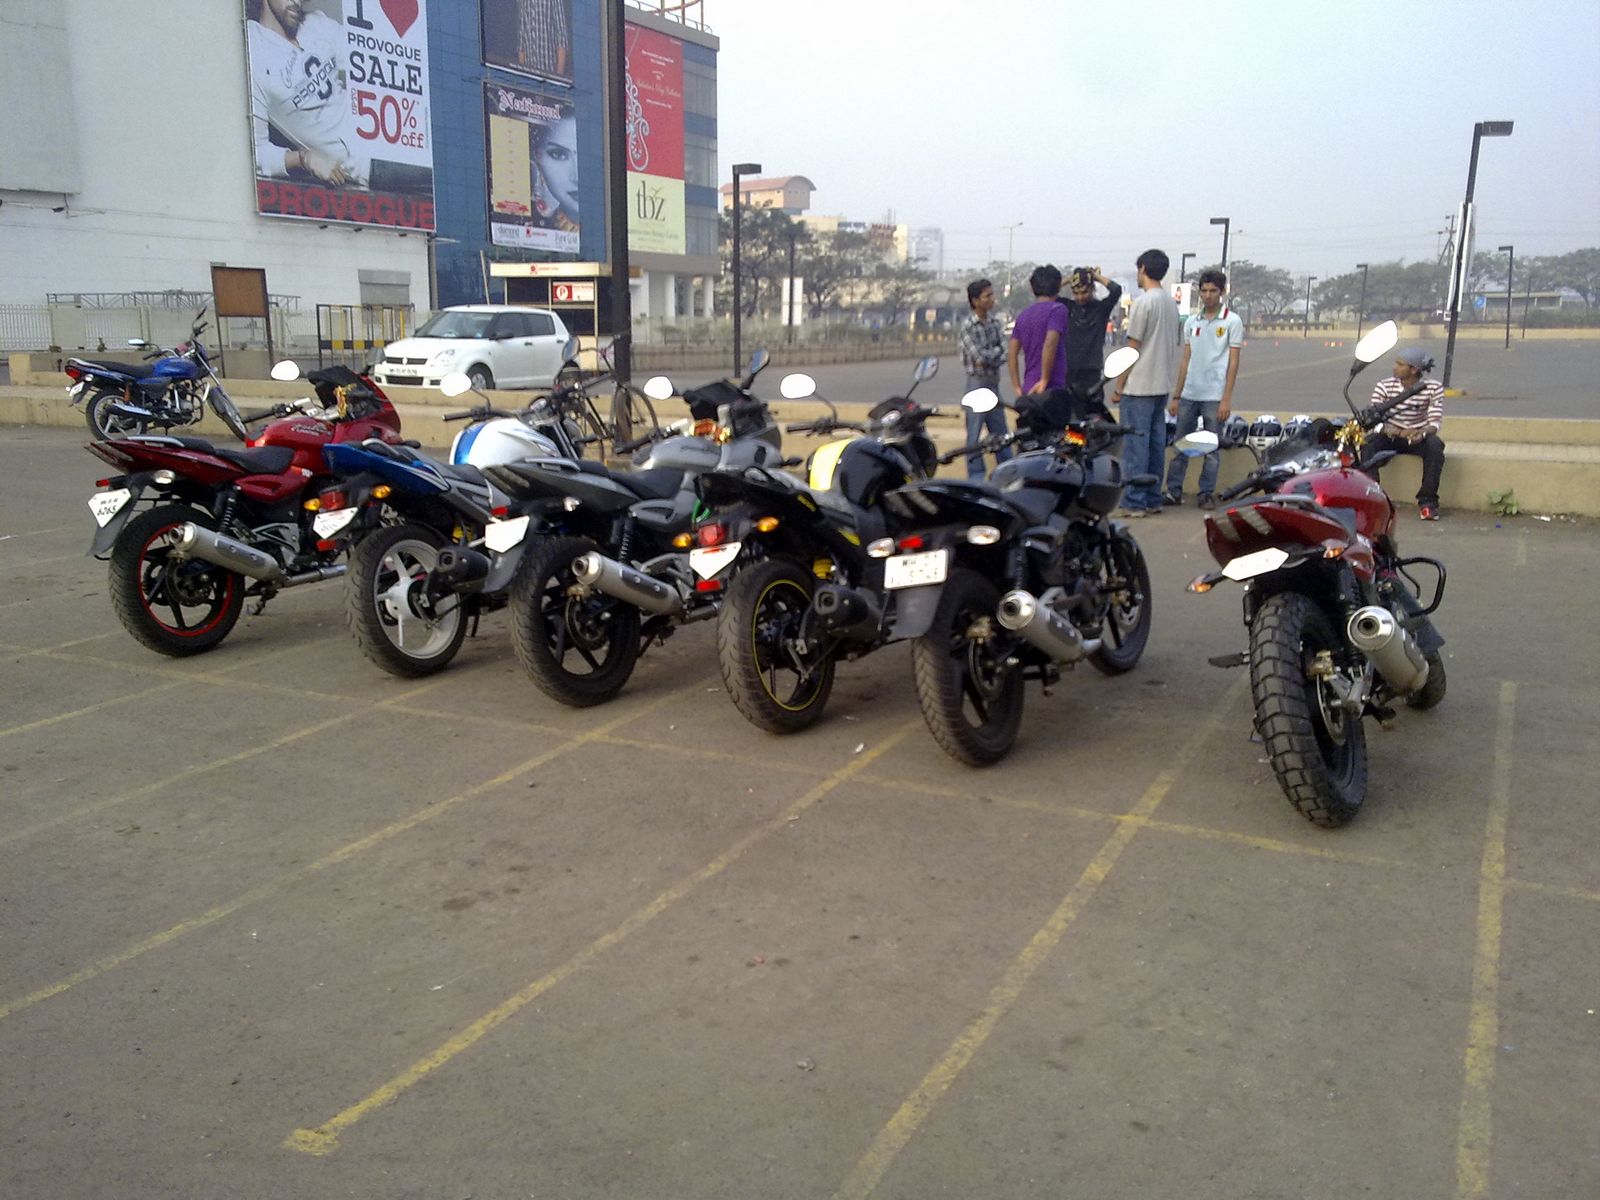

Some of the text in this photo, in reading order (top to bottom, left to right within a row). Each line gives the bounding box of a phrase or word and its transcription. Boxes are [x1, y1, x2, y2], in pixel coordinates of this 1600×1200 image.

[347, 32, 421, 61] PROVOGUE
[349, 50, 423, 96] SALE
[401, 132, 424, 149] off
[257, 181, 434, 230] PROVOGUE
[637, 180, 666, 222] tbz
